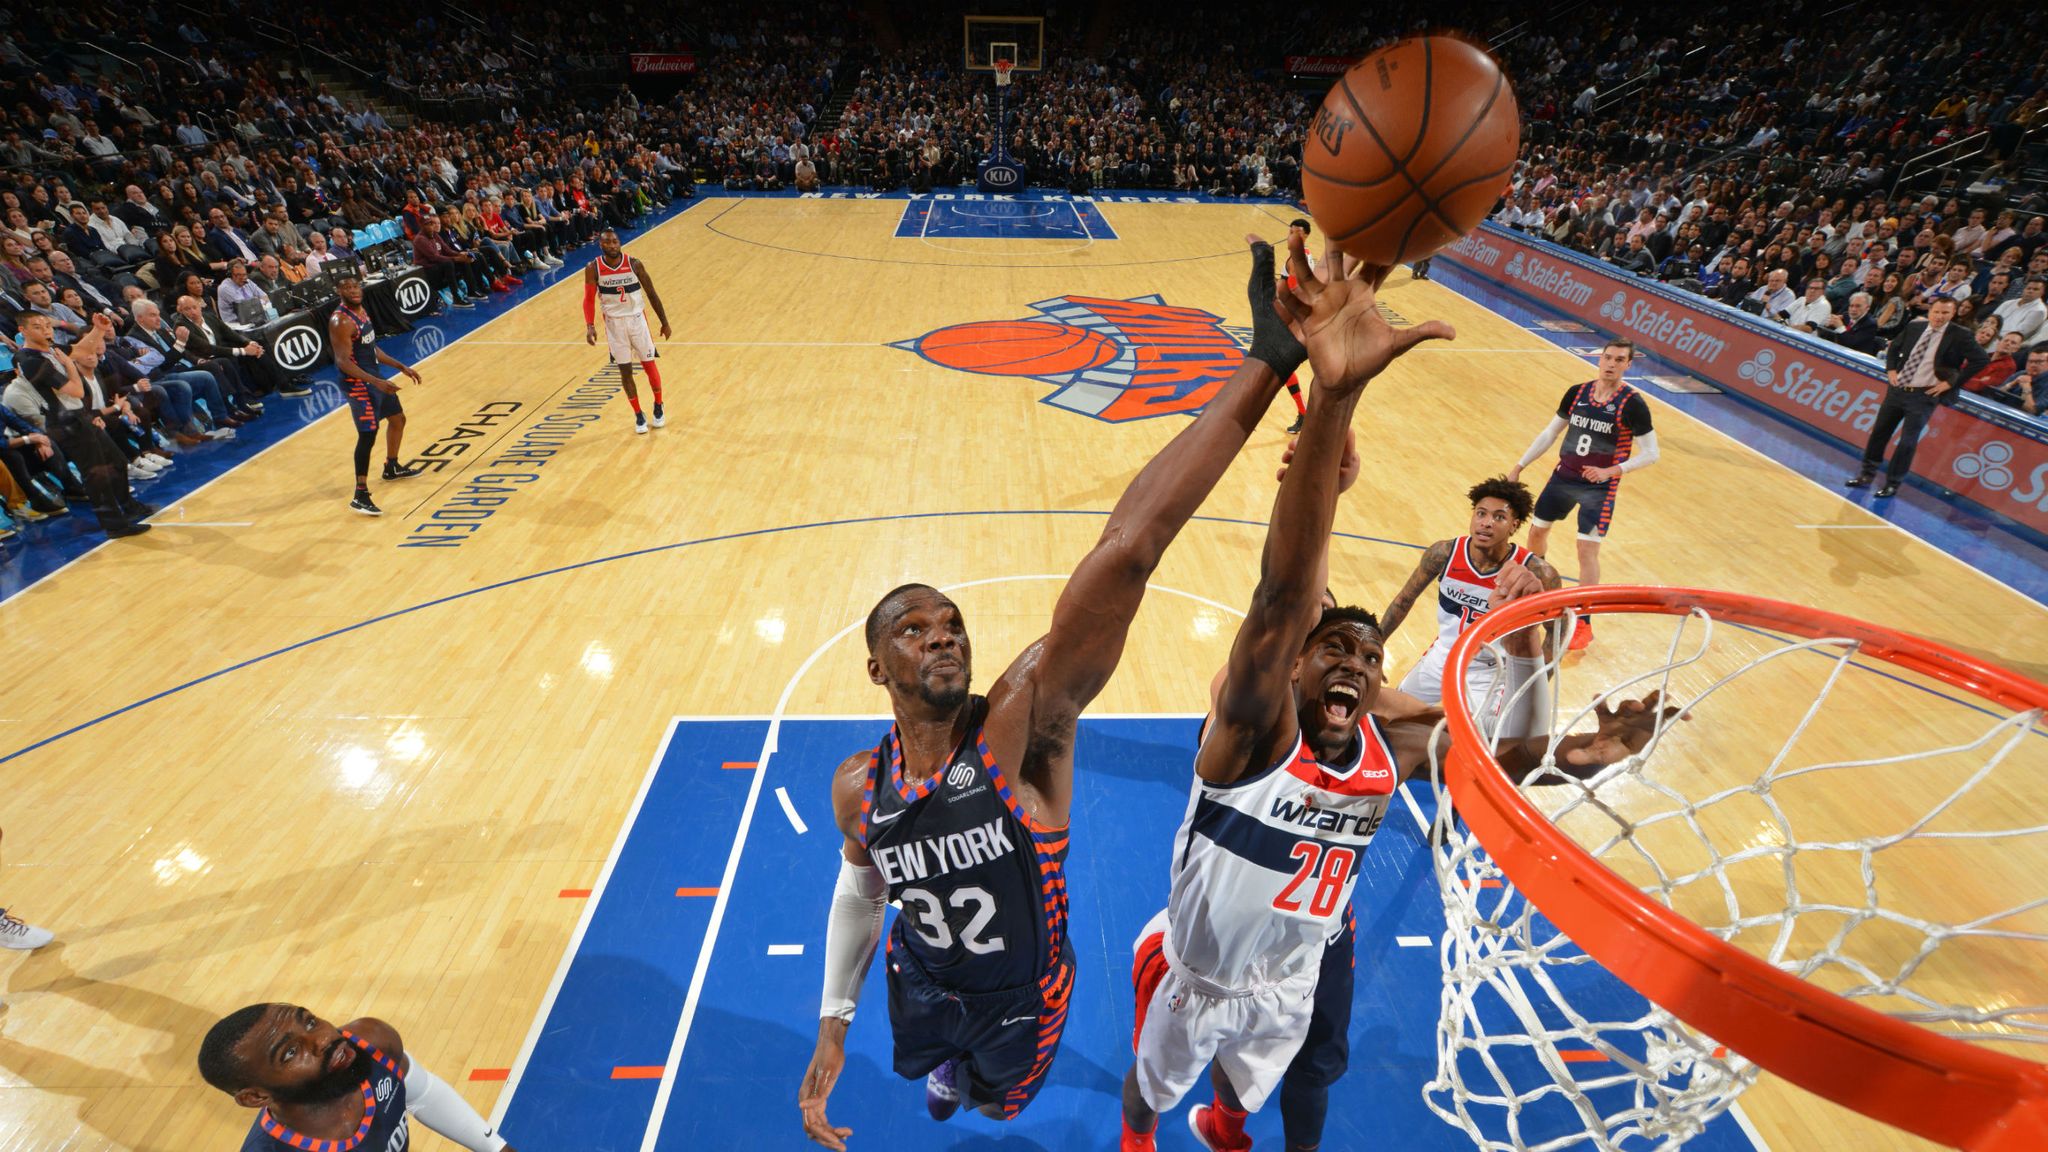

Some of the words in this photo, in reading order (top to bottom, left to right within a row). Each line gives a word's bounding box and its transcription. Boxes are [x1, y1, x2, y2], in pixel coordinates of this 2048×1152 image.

[632, 56, 696, 72] Budweiser
[990, 170, 1012, 182] KIA
[907, 193, 1017, 201] YORK
[1042, 195, 1200, 203] KNICKS
[603, 276, 633, 286] wizards
[616, 286, 627, 303] 2
[401, 283, 426, 309] KIA
[1623, 299, 1725, 363] StateFarm
[280, 332, 317, 364] KIA
[404, 401, 523, 473] CHASE
[1570, 413, 1590, 429] NEW
[1590, 418, 1614, 434] YORK
[489, 414, 601, 468] SQUARE
[1576, 434, 1592, 457] 8
[397, 473, 541, 548] GARDEN
[1446, 587, 1490, 609] wizar
[1270, 795, 1384, 837] wizards
[870, 840, 928, 884] NEW
[927, 816, 1015, 875] YORK
[1271, 840, 1356, 918] 28
[901, 886, 1006, 955] 32
